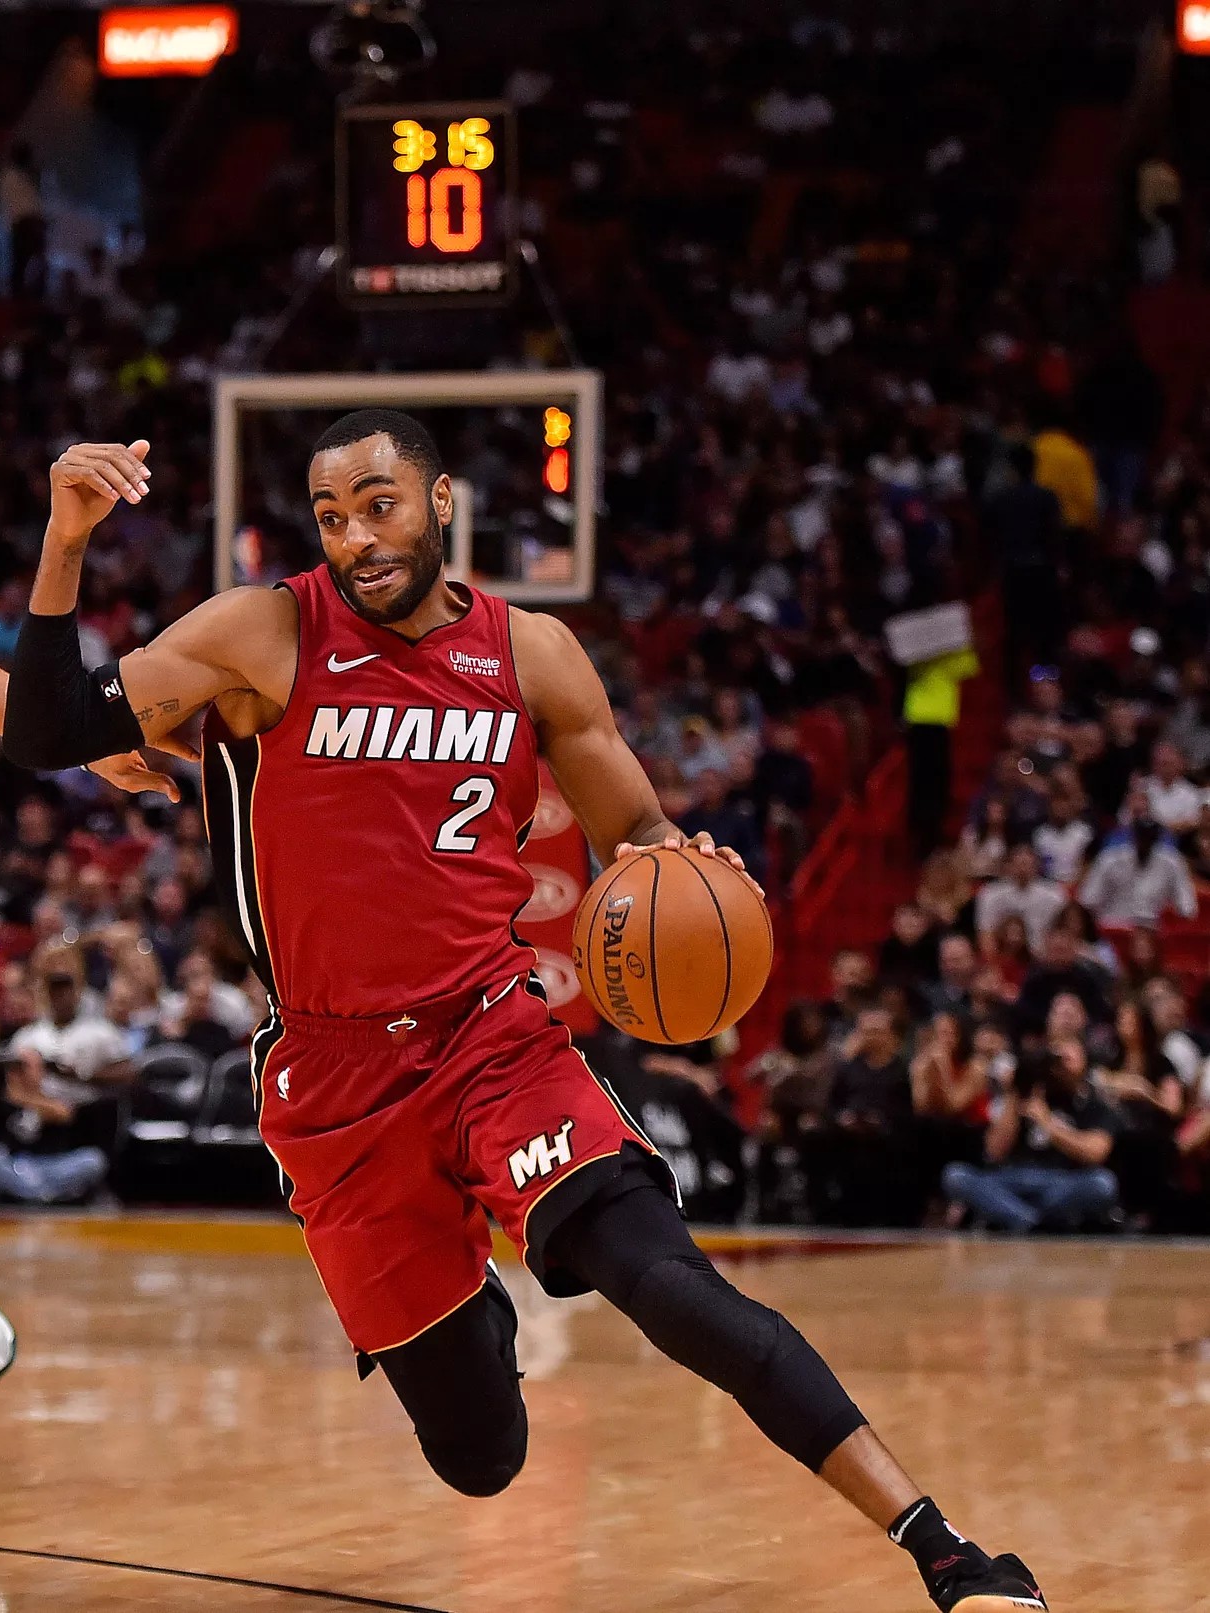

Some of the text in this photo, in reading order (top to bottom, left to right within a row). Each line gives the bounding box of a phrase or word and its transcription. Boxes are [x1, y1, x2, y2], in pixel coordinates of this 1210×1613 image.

[406, 167, 482, 253] 10
[449, 649, 501, 669] Ultimate
[453, 664, 500, 677] SOFTWARE
[304, 705, 519, 765] MIAMI
[434, 775, 497, 853] 2
[604, 894, 645, 1026] SPALDING
